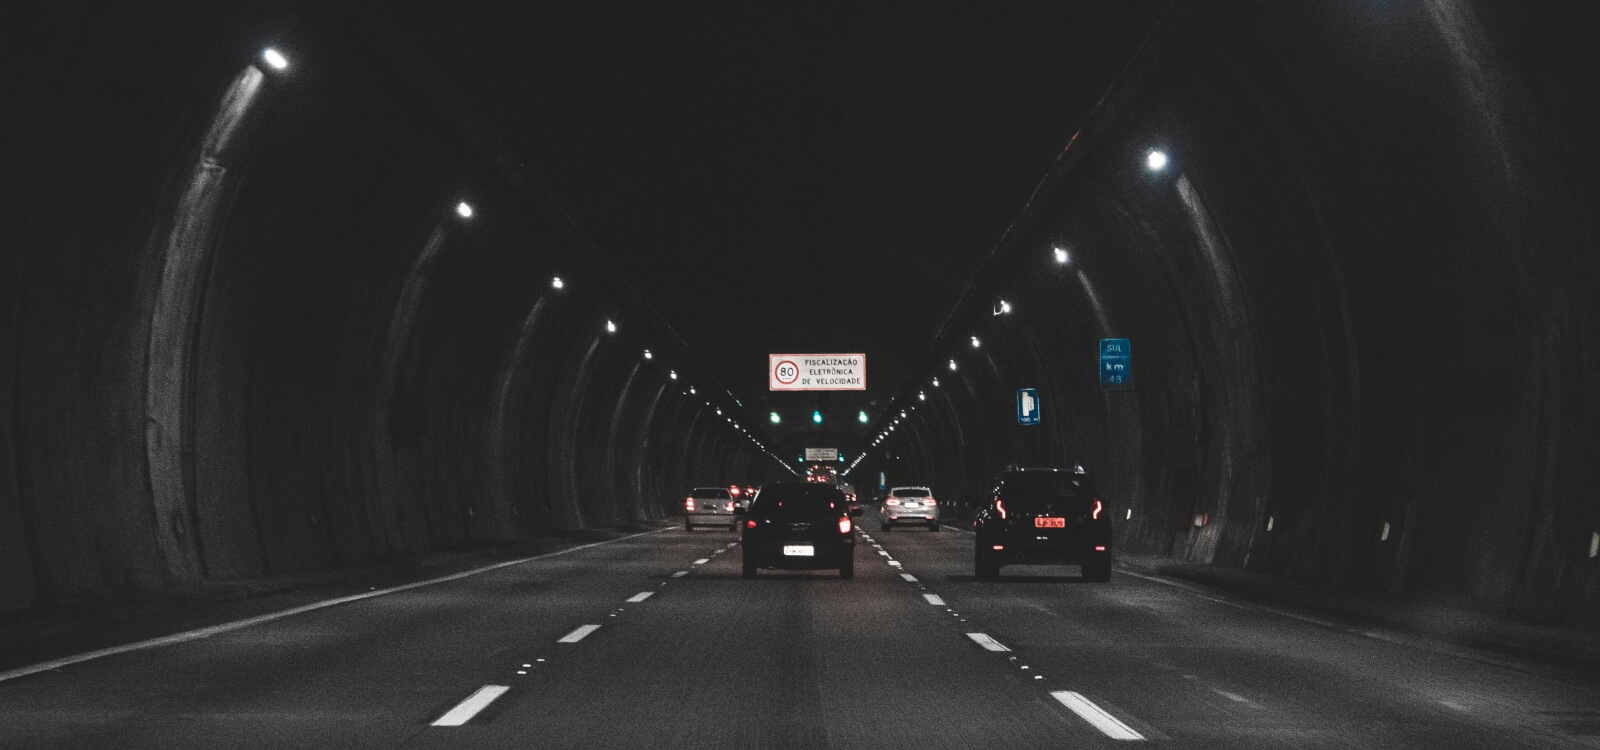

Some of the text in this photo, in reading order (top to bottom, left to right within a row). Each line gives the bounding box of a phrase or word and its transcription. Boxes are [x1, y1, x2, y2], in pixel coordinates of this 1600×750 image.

[1107, 344, 1121, 352] SUL
[1106, 363, 1124, 371] km
[780, 367, 794, 377] 80
